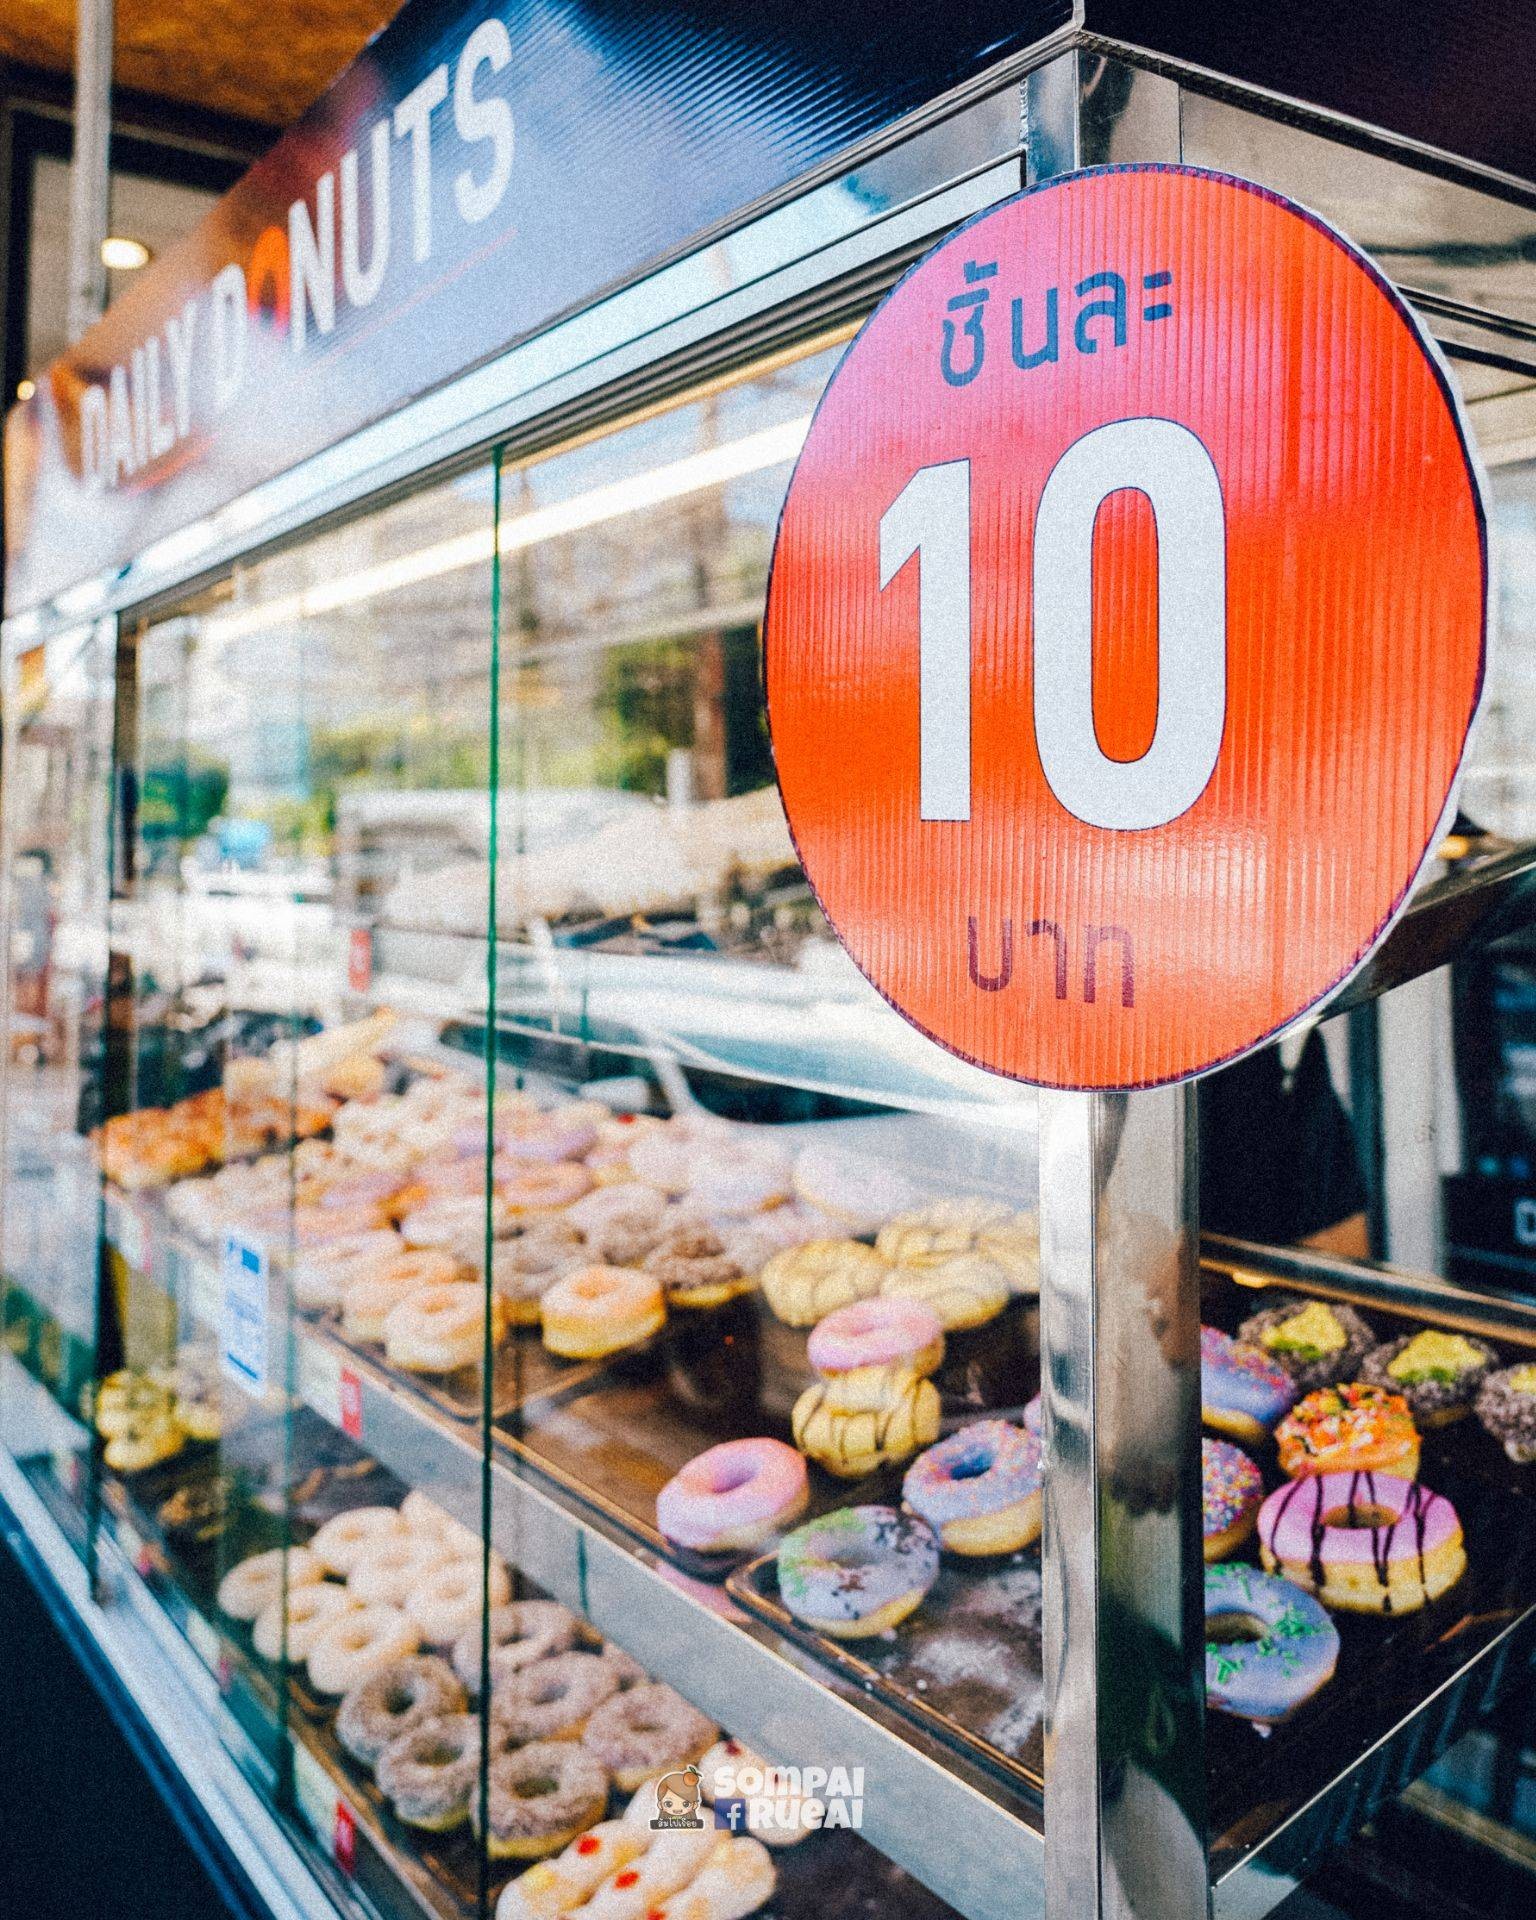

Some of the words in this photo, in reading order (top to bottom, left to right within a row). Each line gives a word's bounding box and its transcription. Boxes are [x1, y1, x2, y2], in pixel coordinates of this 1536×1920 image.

[79, 298, 198, 490] DAILY
[210, 18, 516, 410] DONUTS
[940, 259, 1174, 388] ชิ้นละ
[878, 416, 1228, 831] 10
[967, 915, 1135, 1009] บาท
